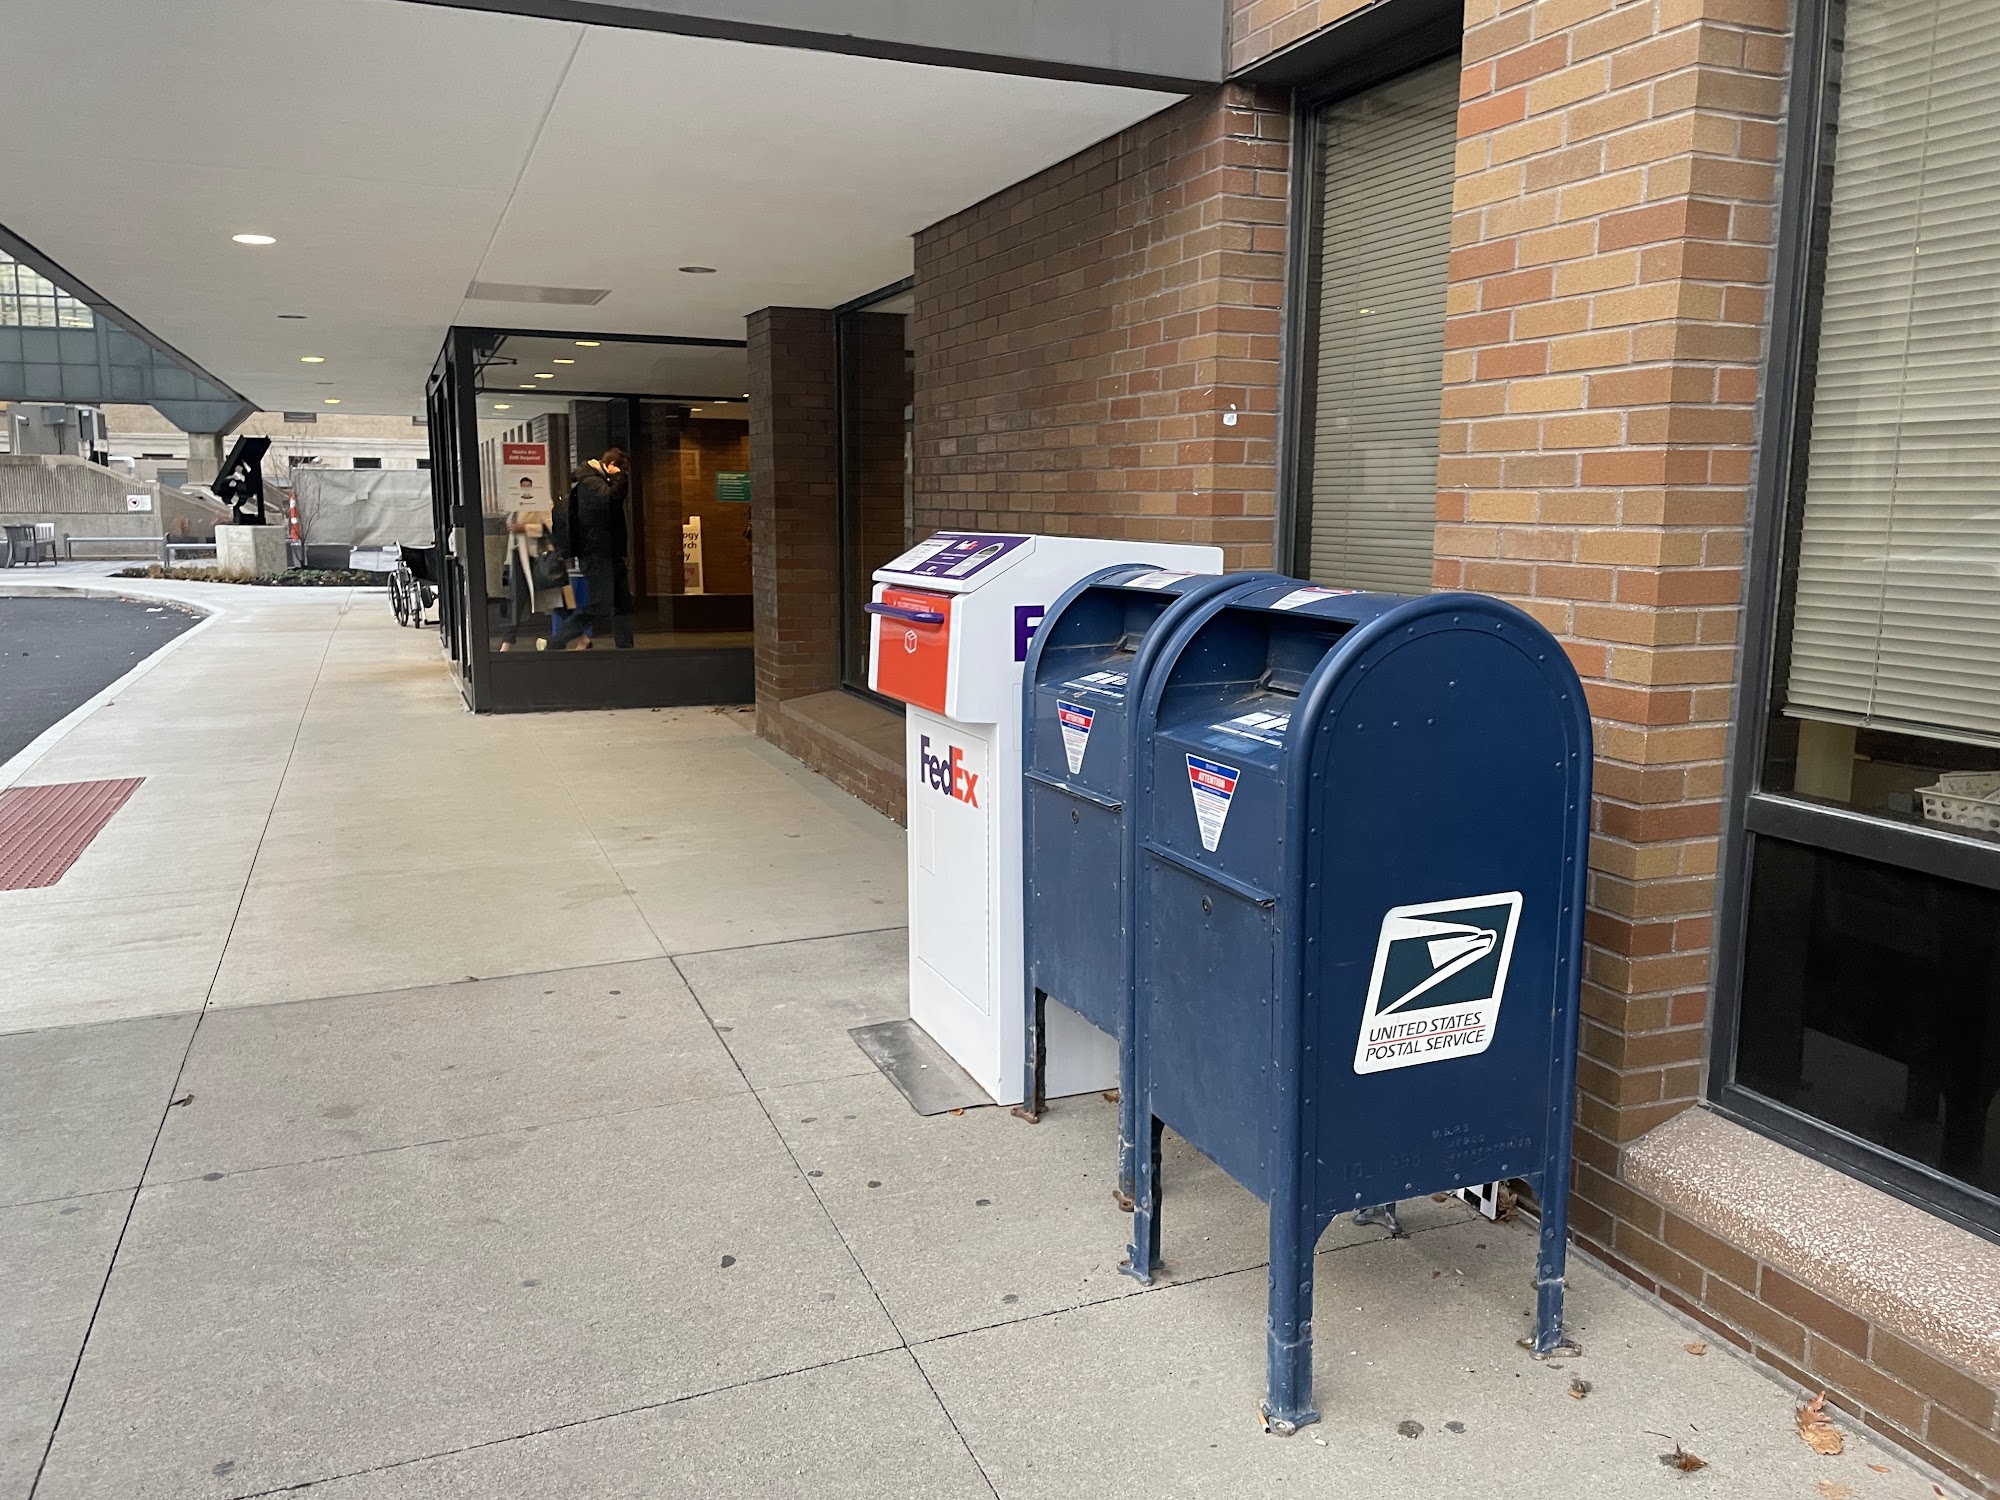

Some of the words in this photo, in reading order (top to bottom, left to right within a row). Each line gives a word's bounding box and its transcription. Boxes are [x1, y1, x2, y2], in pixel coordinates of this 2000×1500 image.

[920, 734, 979, 809] FedEx
[1369, 1020, 1428, 1042] UNITED
[1429, 1011, 1482, 1033] STATES
[1365, 1040, 1422, 1061] POSTAL
[1425, 1029, 1486, 1052] SERVICE
